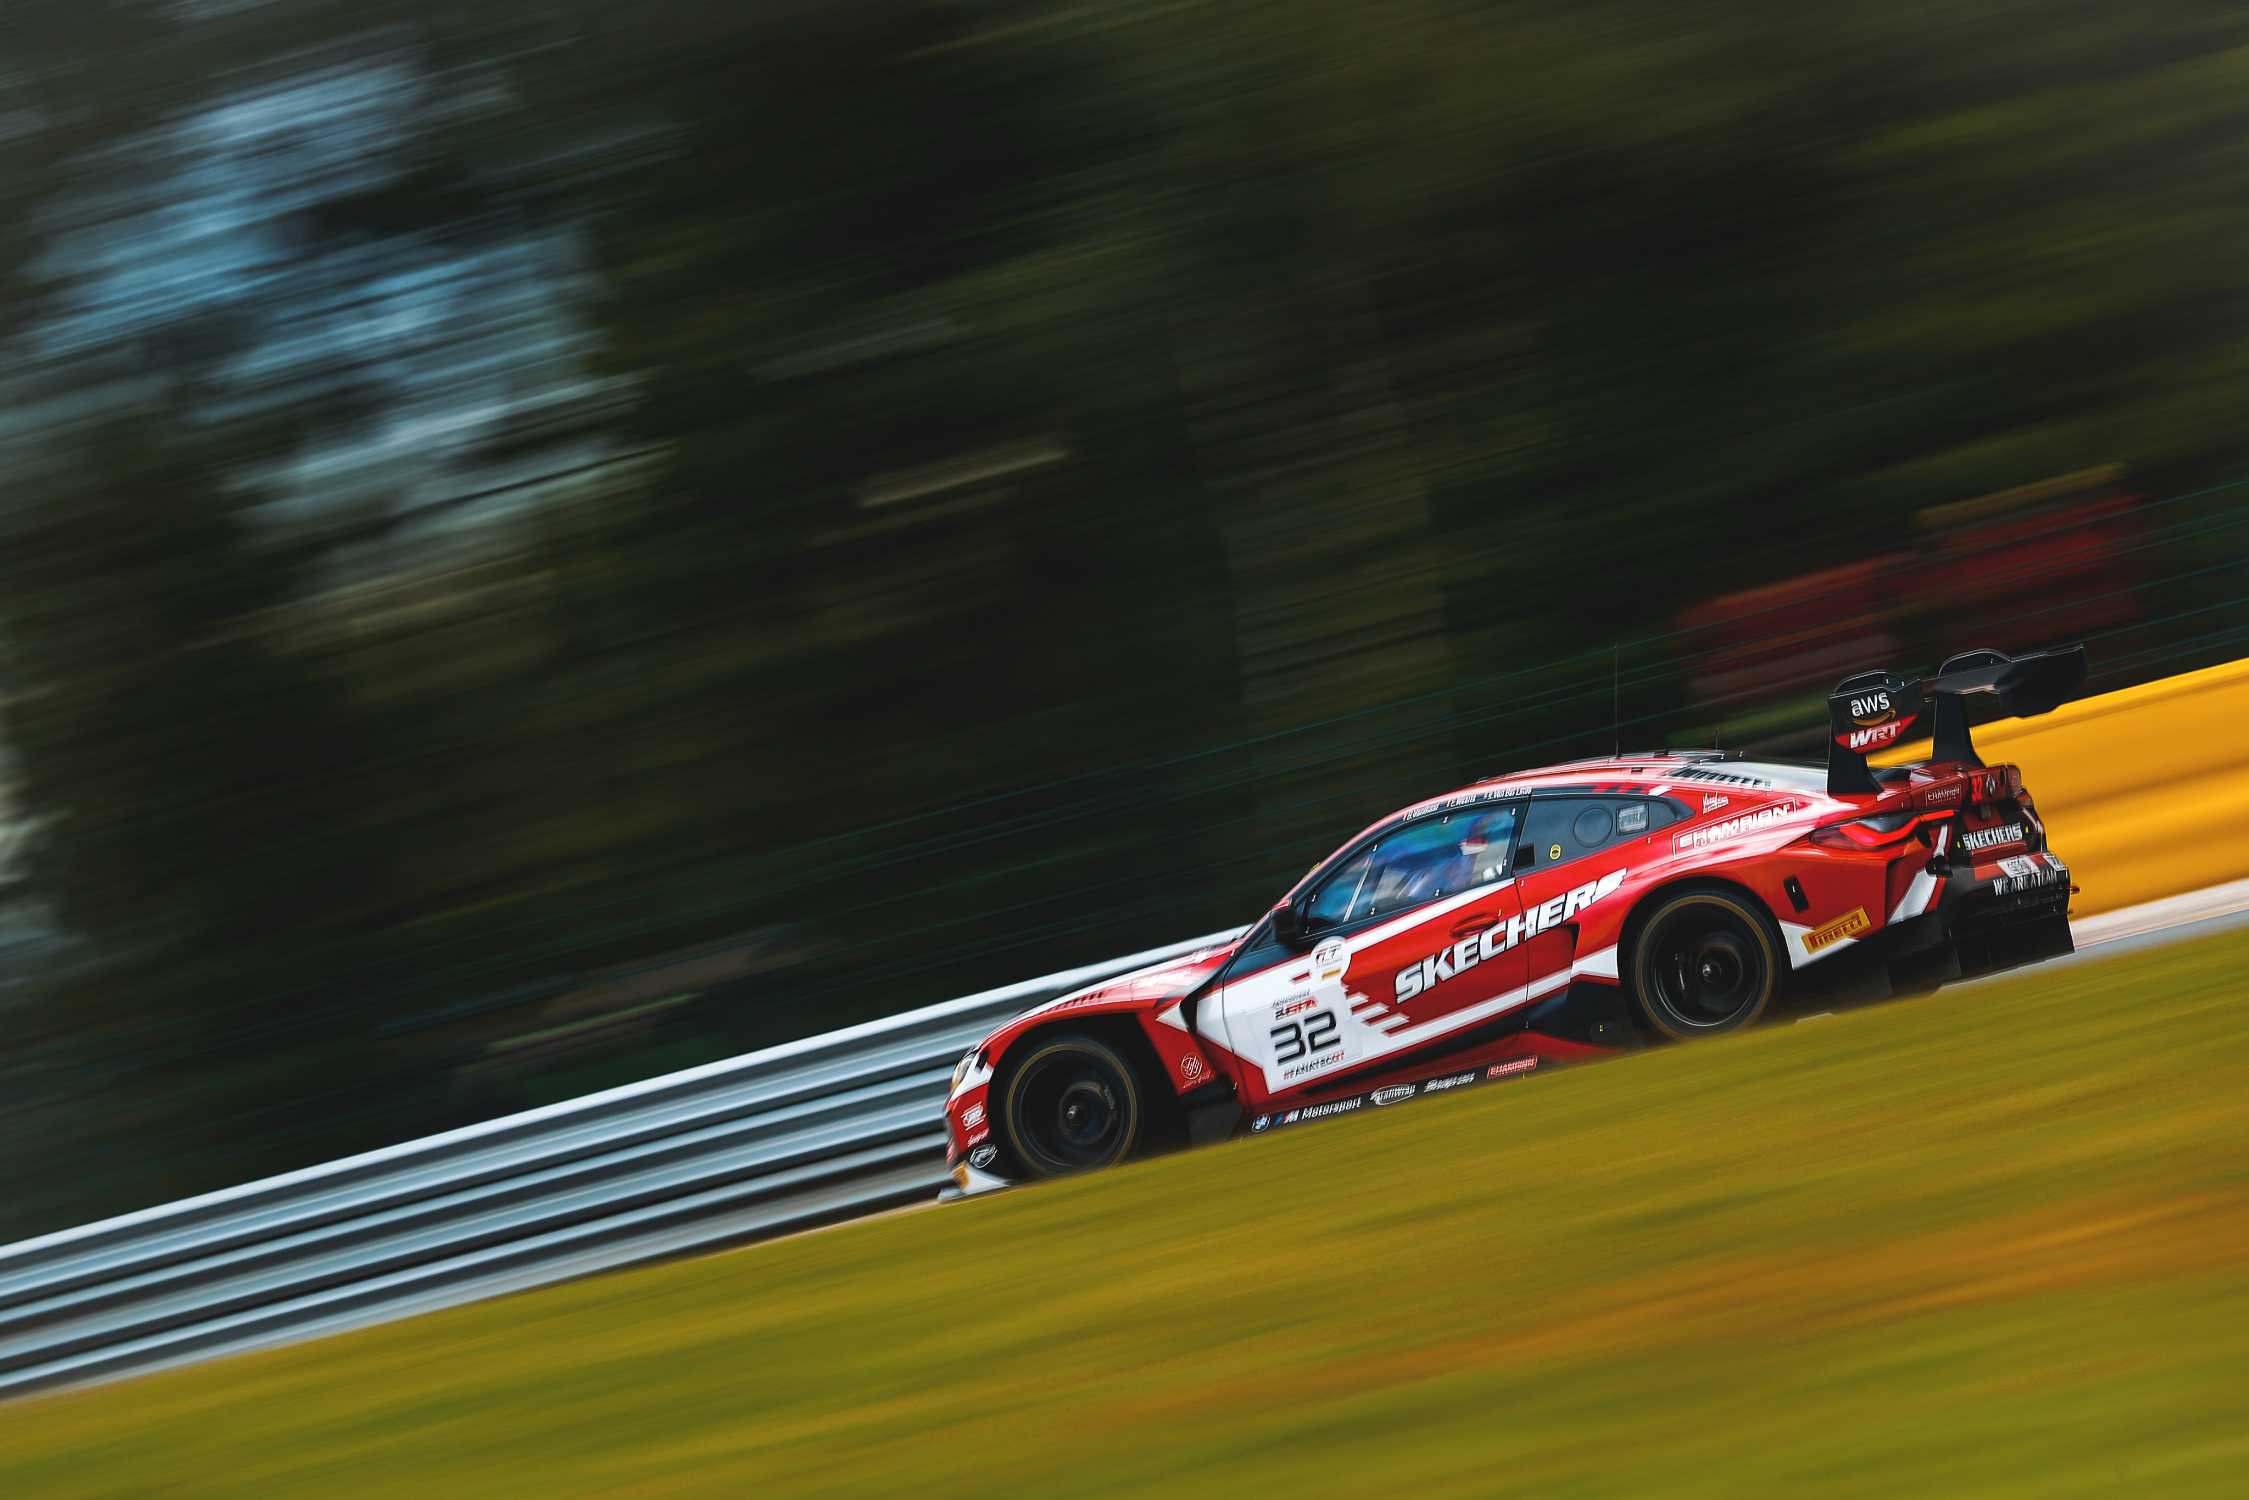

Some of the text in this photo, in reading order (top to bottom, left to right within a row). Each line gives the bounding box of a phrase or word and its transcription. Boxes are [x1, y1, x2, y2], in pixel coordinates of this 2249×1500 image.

[1851, 692, 1890, 717] aws
[1850, 720, 1900, 748] WRT
[1962, 822, 2023, 851] SKECHERS
[1395, 867, 1628, 1004] SKECHERS
[1807, 911, 1863, 950] PIRELLI
[1270, 1008, 1341, 1066] 32
[1301, 1097, 1362, 1120] Motorsport
